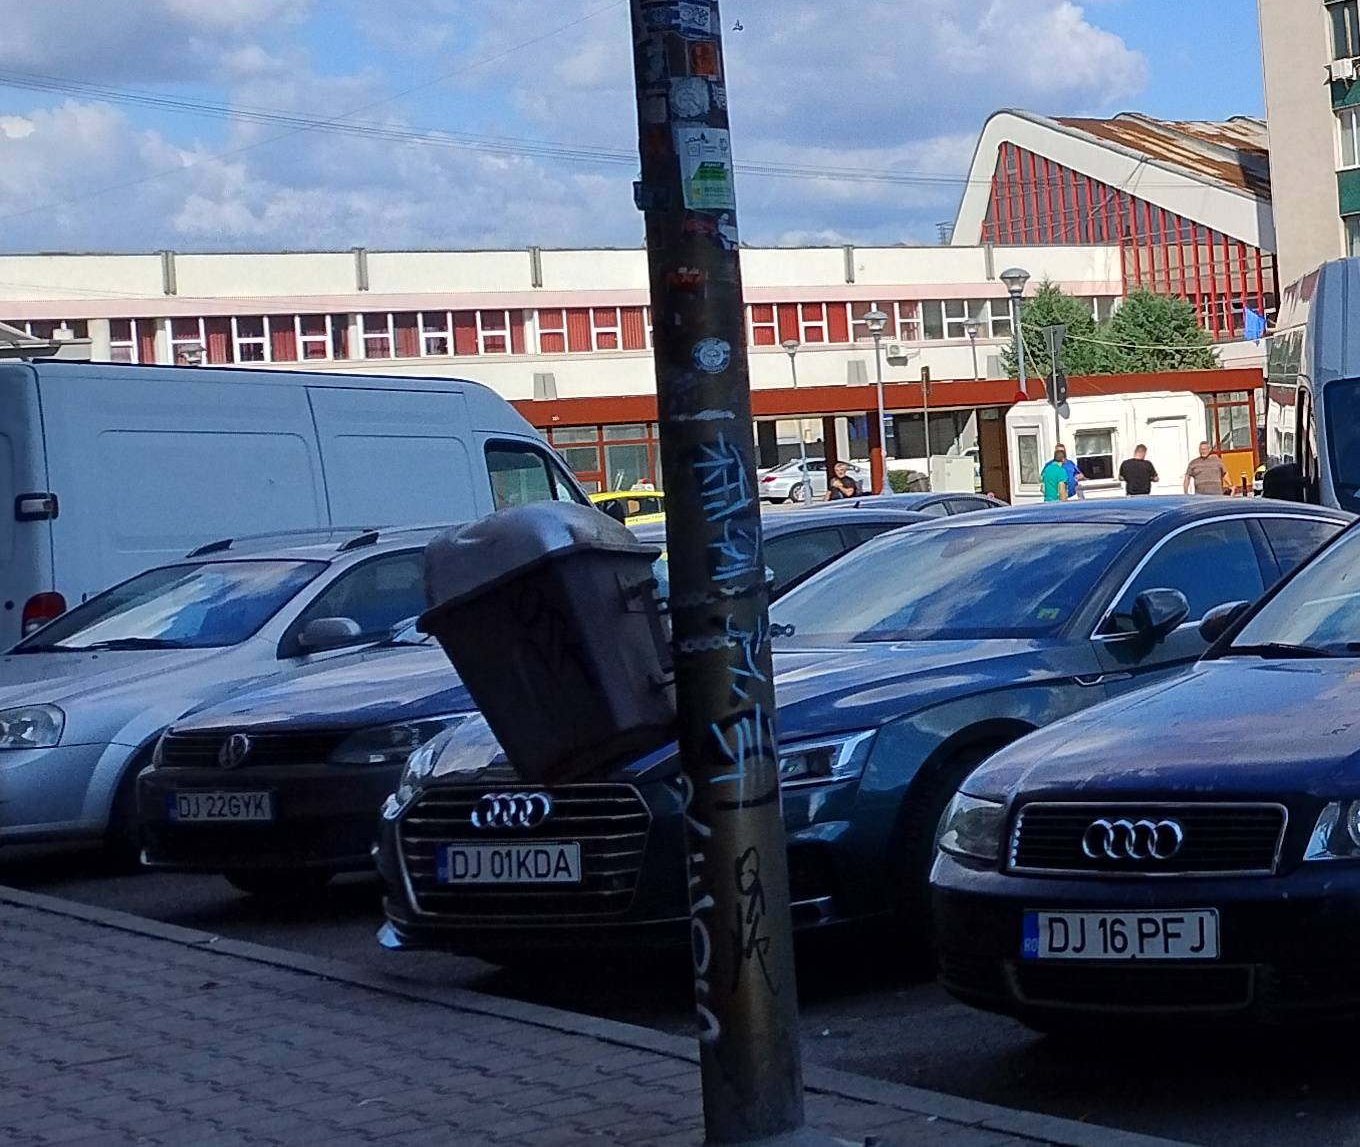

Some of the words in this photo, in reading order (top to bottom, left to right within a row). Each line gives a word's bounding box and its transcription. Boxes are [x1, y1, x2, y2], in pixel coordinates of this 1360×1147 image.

[179, 796, 200, 818] DJ
[206, 795, 265, 817] 22GYK
[452, 850, 481, 879] DJ
[491, 849, 572, 878] 01KDA
[1048, 917, 1086, 954] DJ
[1098, 917, 1129, 954] 16
[1137, 916, 1205, 954] PFJ
